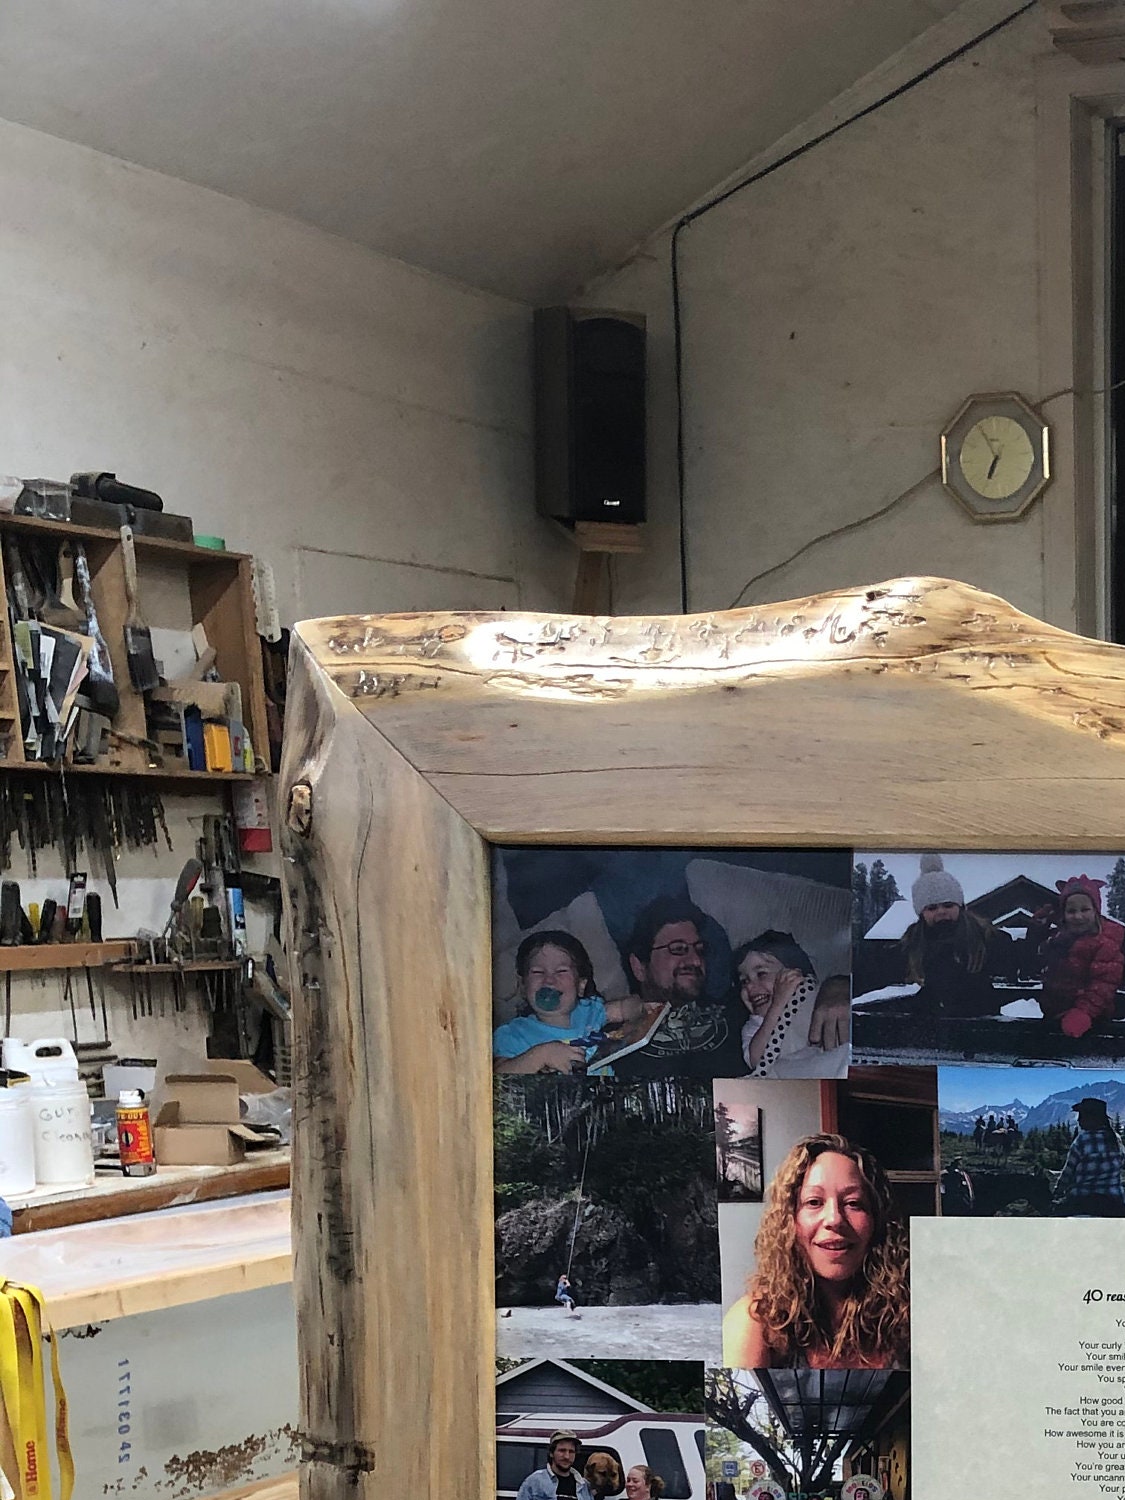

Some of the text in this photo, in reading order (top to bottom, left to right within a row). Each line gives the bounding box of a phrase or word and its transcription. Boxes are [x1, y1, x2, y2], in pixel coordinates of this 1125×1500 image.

[1083, 1289, 1104, 1304] 40
[1078, 1341, 1099, 1349] Your
[1101, 1341, 1122, 1351] curly
[1086, 1352, 1106, 1361] Your
[1058, 1363, 1079, 1371] Your
[1081, 1363, 1103, 1371] smile
[1080, 1396, 1099, 1405] How
[1101, 1396, 1123, 1407] good
[1045, 1407, 1062, 1415] The
[1064, 1407, 1080, 1415] fact
[1082, 1407, 1099, 1415] that
[1100, 1409, 1117, 1418] you
[1044, 1429, 1064, 1437] How
[1109, 1429, 1114, 1438] it
[1117, 1429, 1124, 1438] is
[1097, 1451, 1118, 1459] Your
[26, 1440, 38, 1483] Home
[1070, 1473, 1091, 1481] Your
[1099, 1484, 1120, 1492] Your
